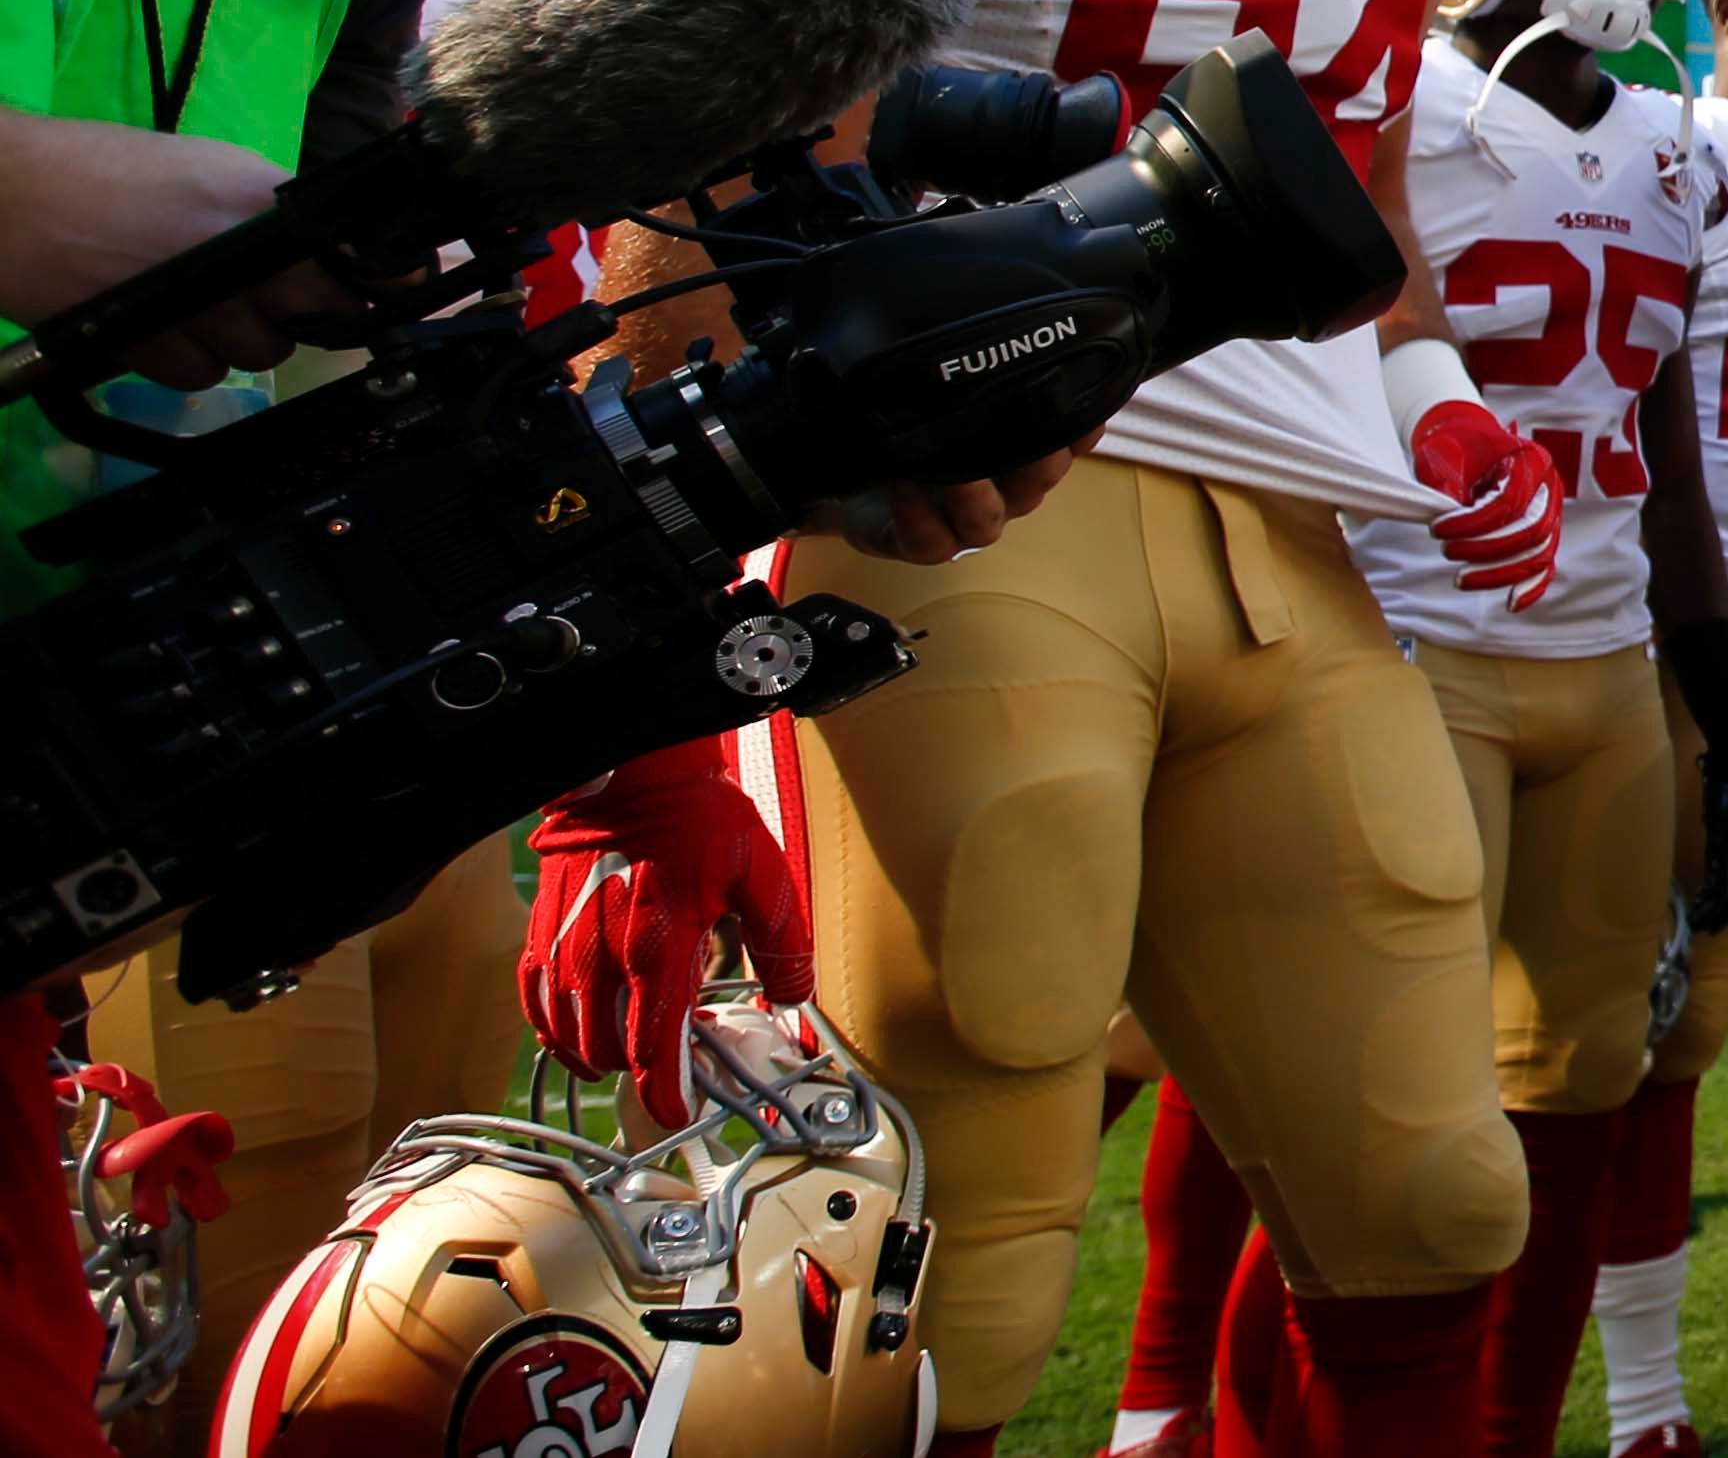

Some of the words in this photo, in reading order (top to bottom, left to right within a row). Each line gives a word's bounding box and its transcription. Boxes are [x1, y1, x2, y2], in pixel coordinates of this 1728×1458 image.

[1136, 217, 1166, 236] INON
[1554, 211, 1632, 235] 49ERS
[939, 315, 1079, 382] FUJINON
[1441, 237, 1690, 499] 25
